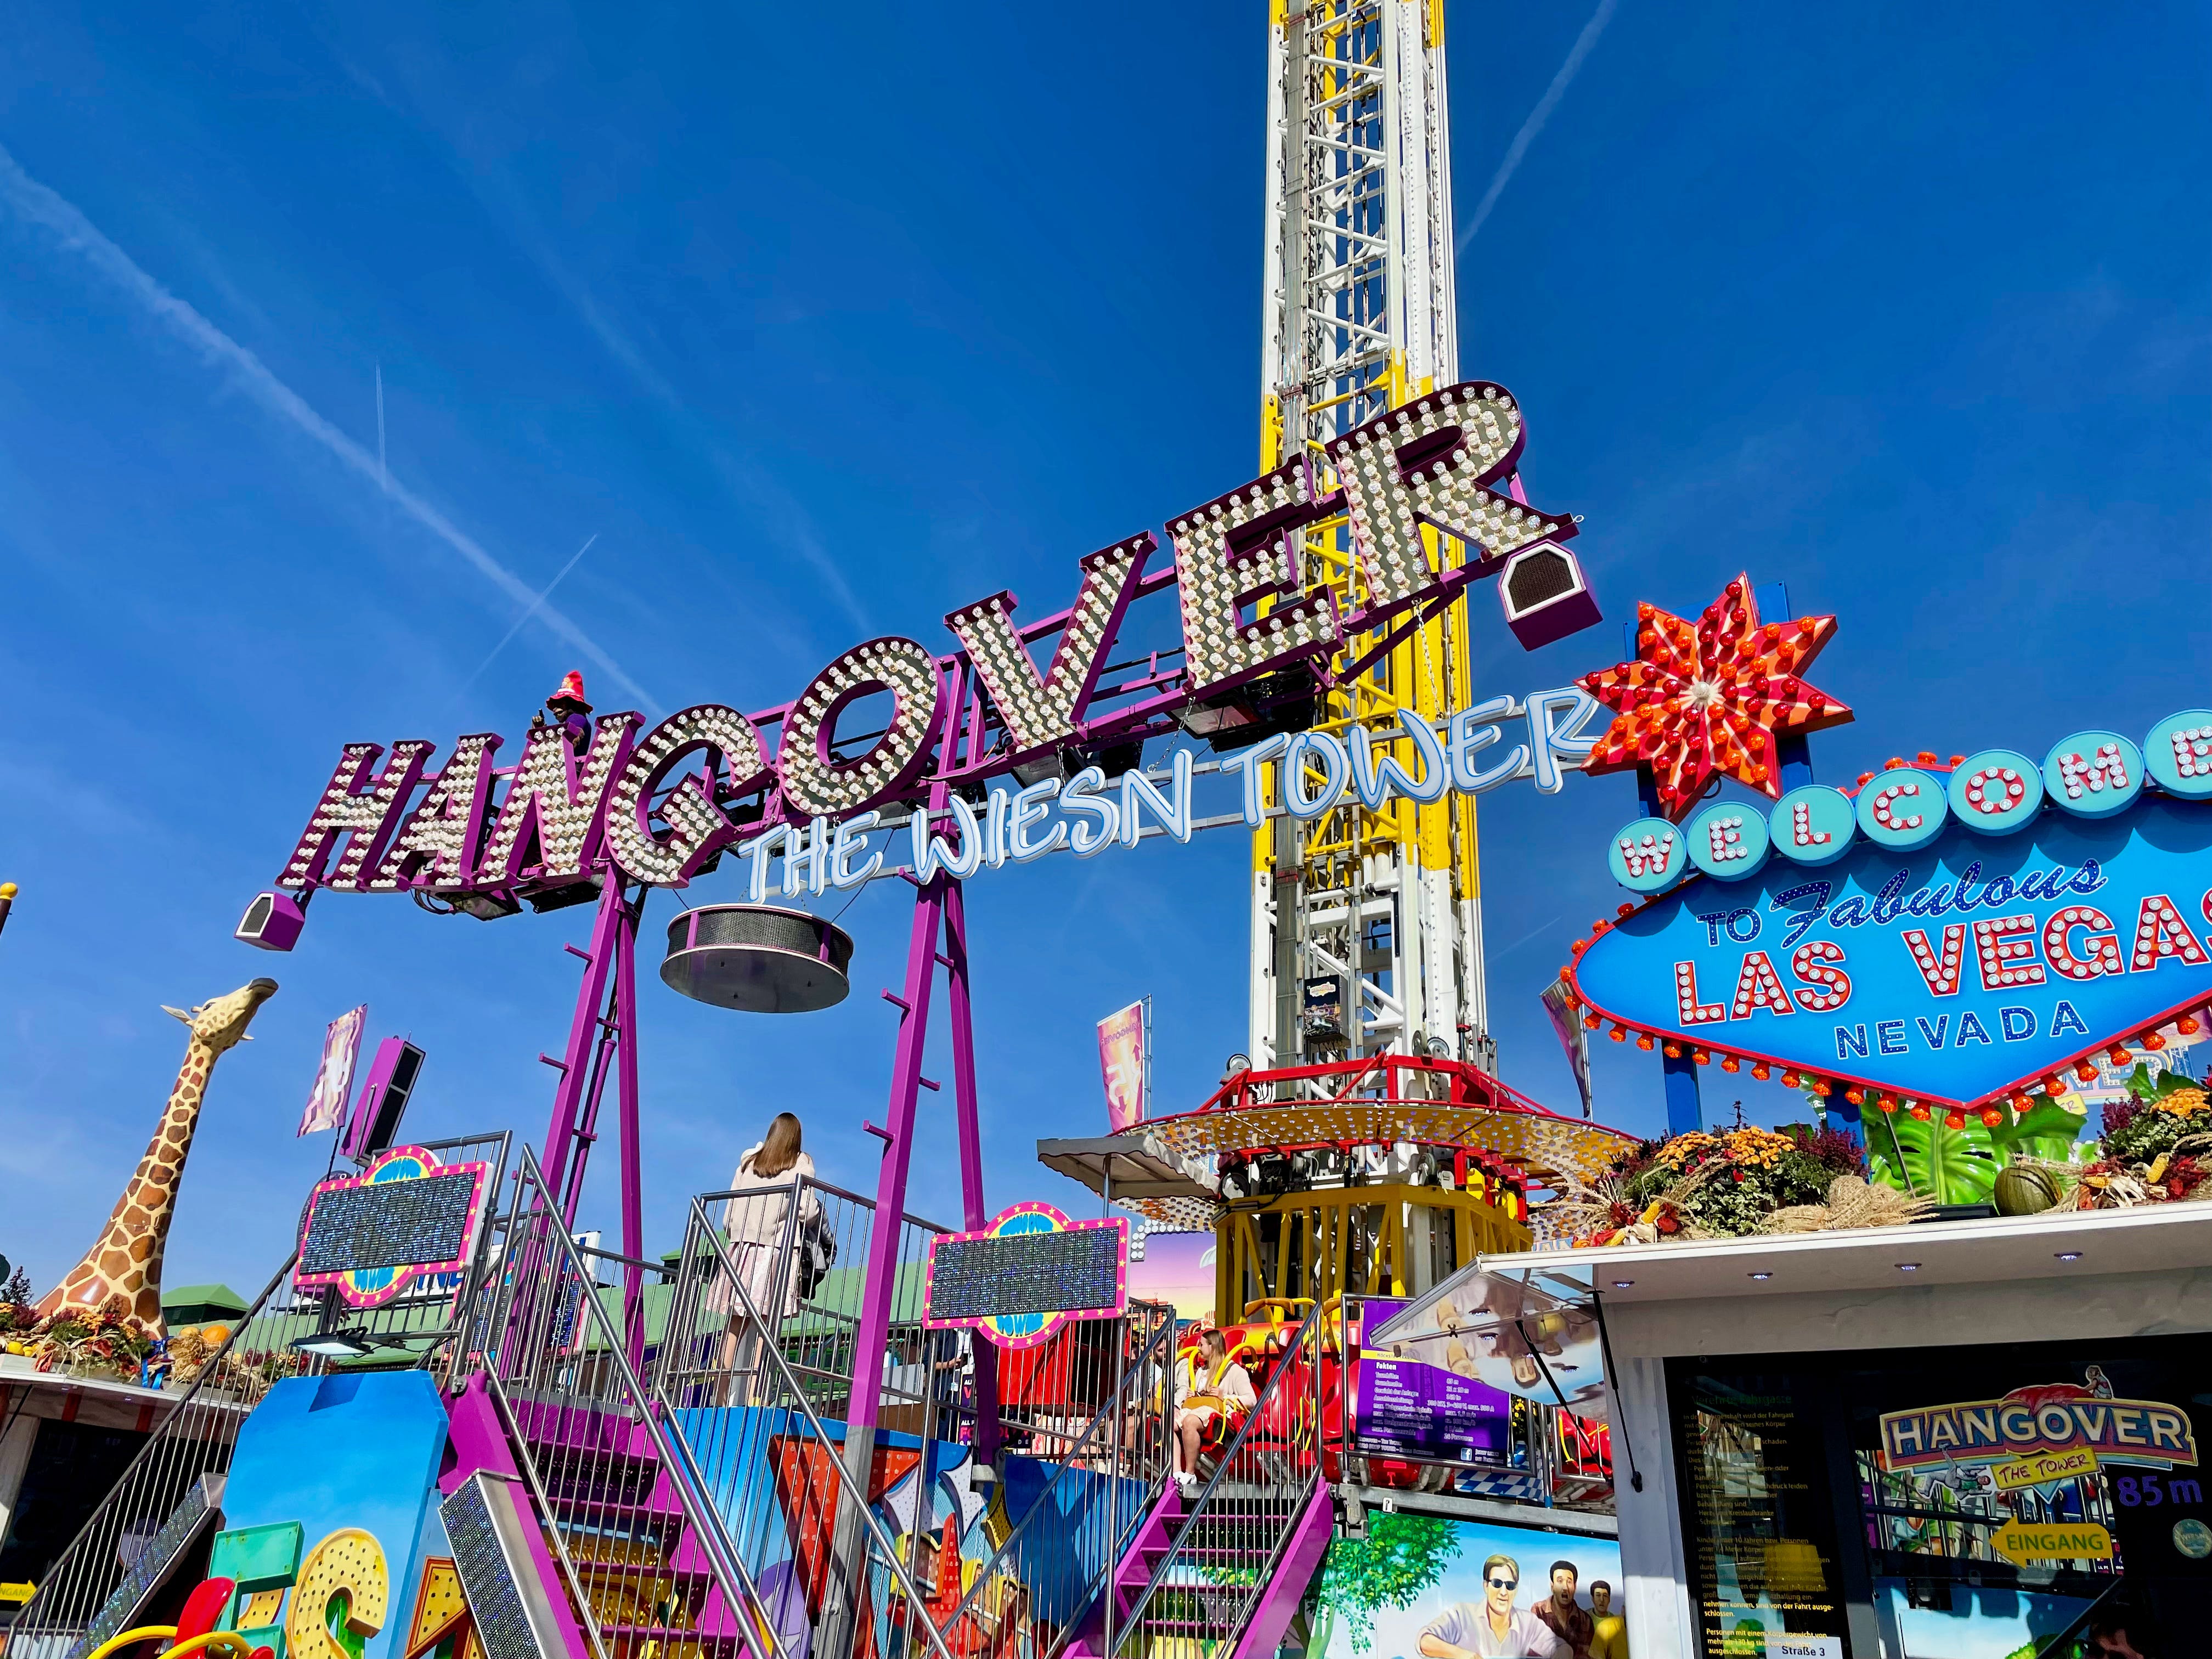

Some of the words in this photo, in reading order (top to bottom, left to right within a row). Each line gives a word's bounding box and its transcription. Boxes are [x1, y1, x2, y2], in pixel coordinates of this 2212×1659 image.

[277, 381, 1580, 893] HANGOVER
[737, 809, 884, 905] THE
[910, 749, 1192, 884] WIESN
[1220, 686, 1601, 831] TOWER
[1616, 723, 2212, 879] WELCOME
[1696, 907, 1762, 947] TO
[1771, 857, 2109, 949] Fabulous
[1673, 940, 1853, 1026] LAS
[1833, 999, 2090, 1060] NEVADA
[1376, 1362, 1397, 1370] Fakten
[1891, 1406, 2184, 1455] HANGOVER
[1997, 1463, 2032, 1485] THE
[2038, 1452, 2090, 1475] TOWER
[2117, 1475, 2163, 1506] 85
[2168, 1479, 2203, 1504] m
[2006, 1533, 2105, 1553] EINGANG
[1782, 1645, 1816, 1657] Straße
[1819, 1647, 1825, 1657] 3
